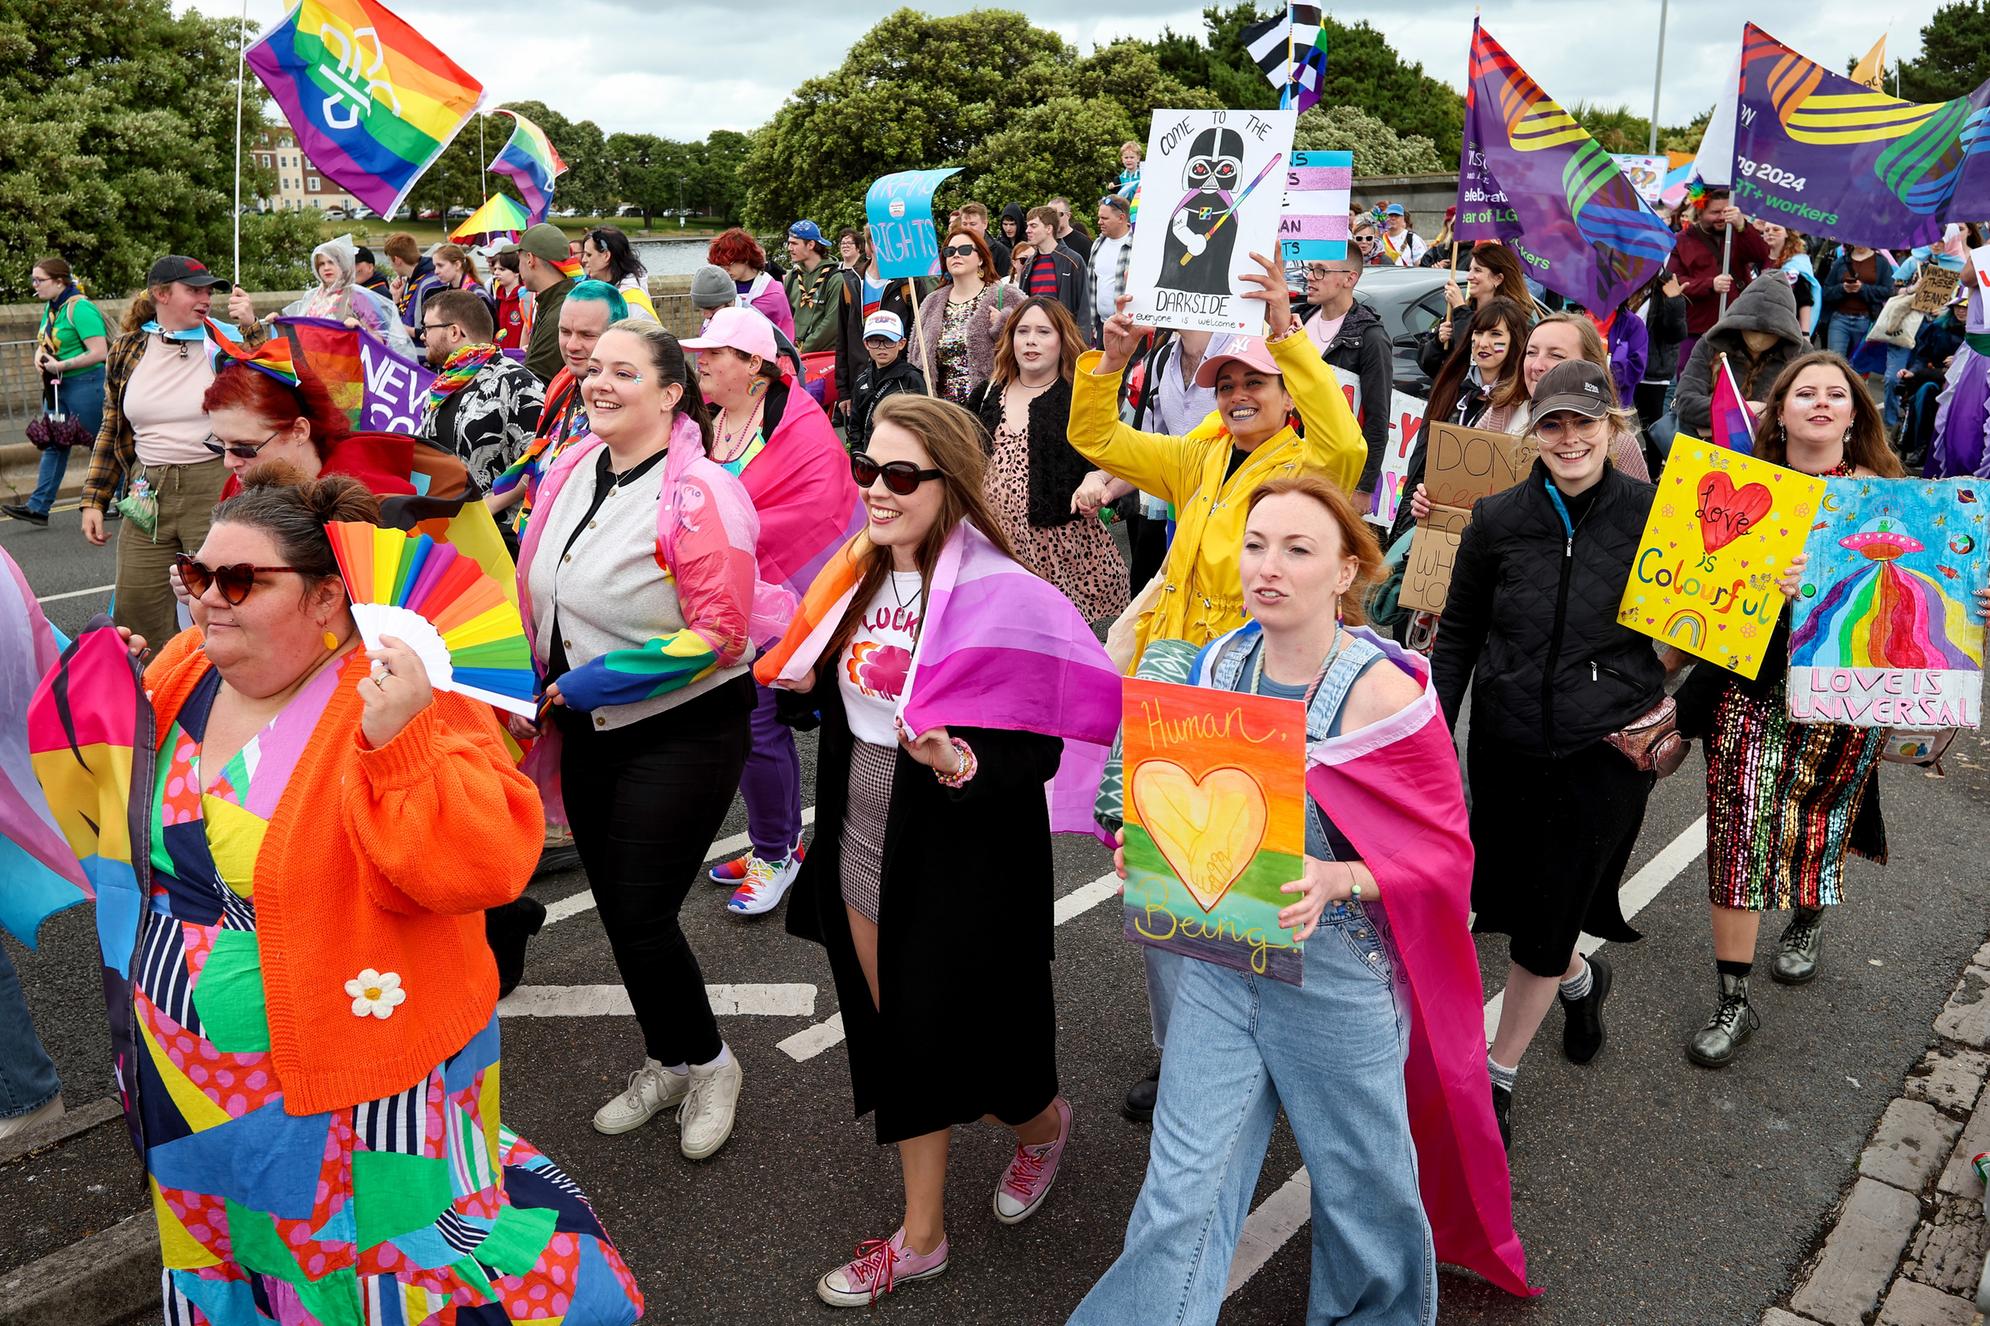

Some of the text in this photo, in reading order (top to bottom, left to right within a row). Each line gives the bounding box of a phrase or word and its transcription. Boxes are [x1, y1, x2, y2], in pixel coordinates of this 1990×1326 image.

[1160, 111, 1272, 156] COME TO THE
[1756, 163, 1806, 192] 2024
[1478, 209, 1492, 223] of
[1765, 194, 1839, 225] workers
[869, 218, 939, 263] RIGHTS
[1155, 290, 1230, 317] DARKSIDE
[1135, 312, 1172, 325] everyone
[1197, 319, 1236, 329] welcome
[1695, 484, 1752, 536] Love
[1695, 552, 1718, 573] is
[1637, 547, 1771, 625] Colourful
[1811, 668, 1943, 695] LOVE IS
[1791, 694, 1977, 727] UNIVERSAL
